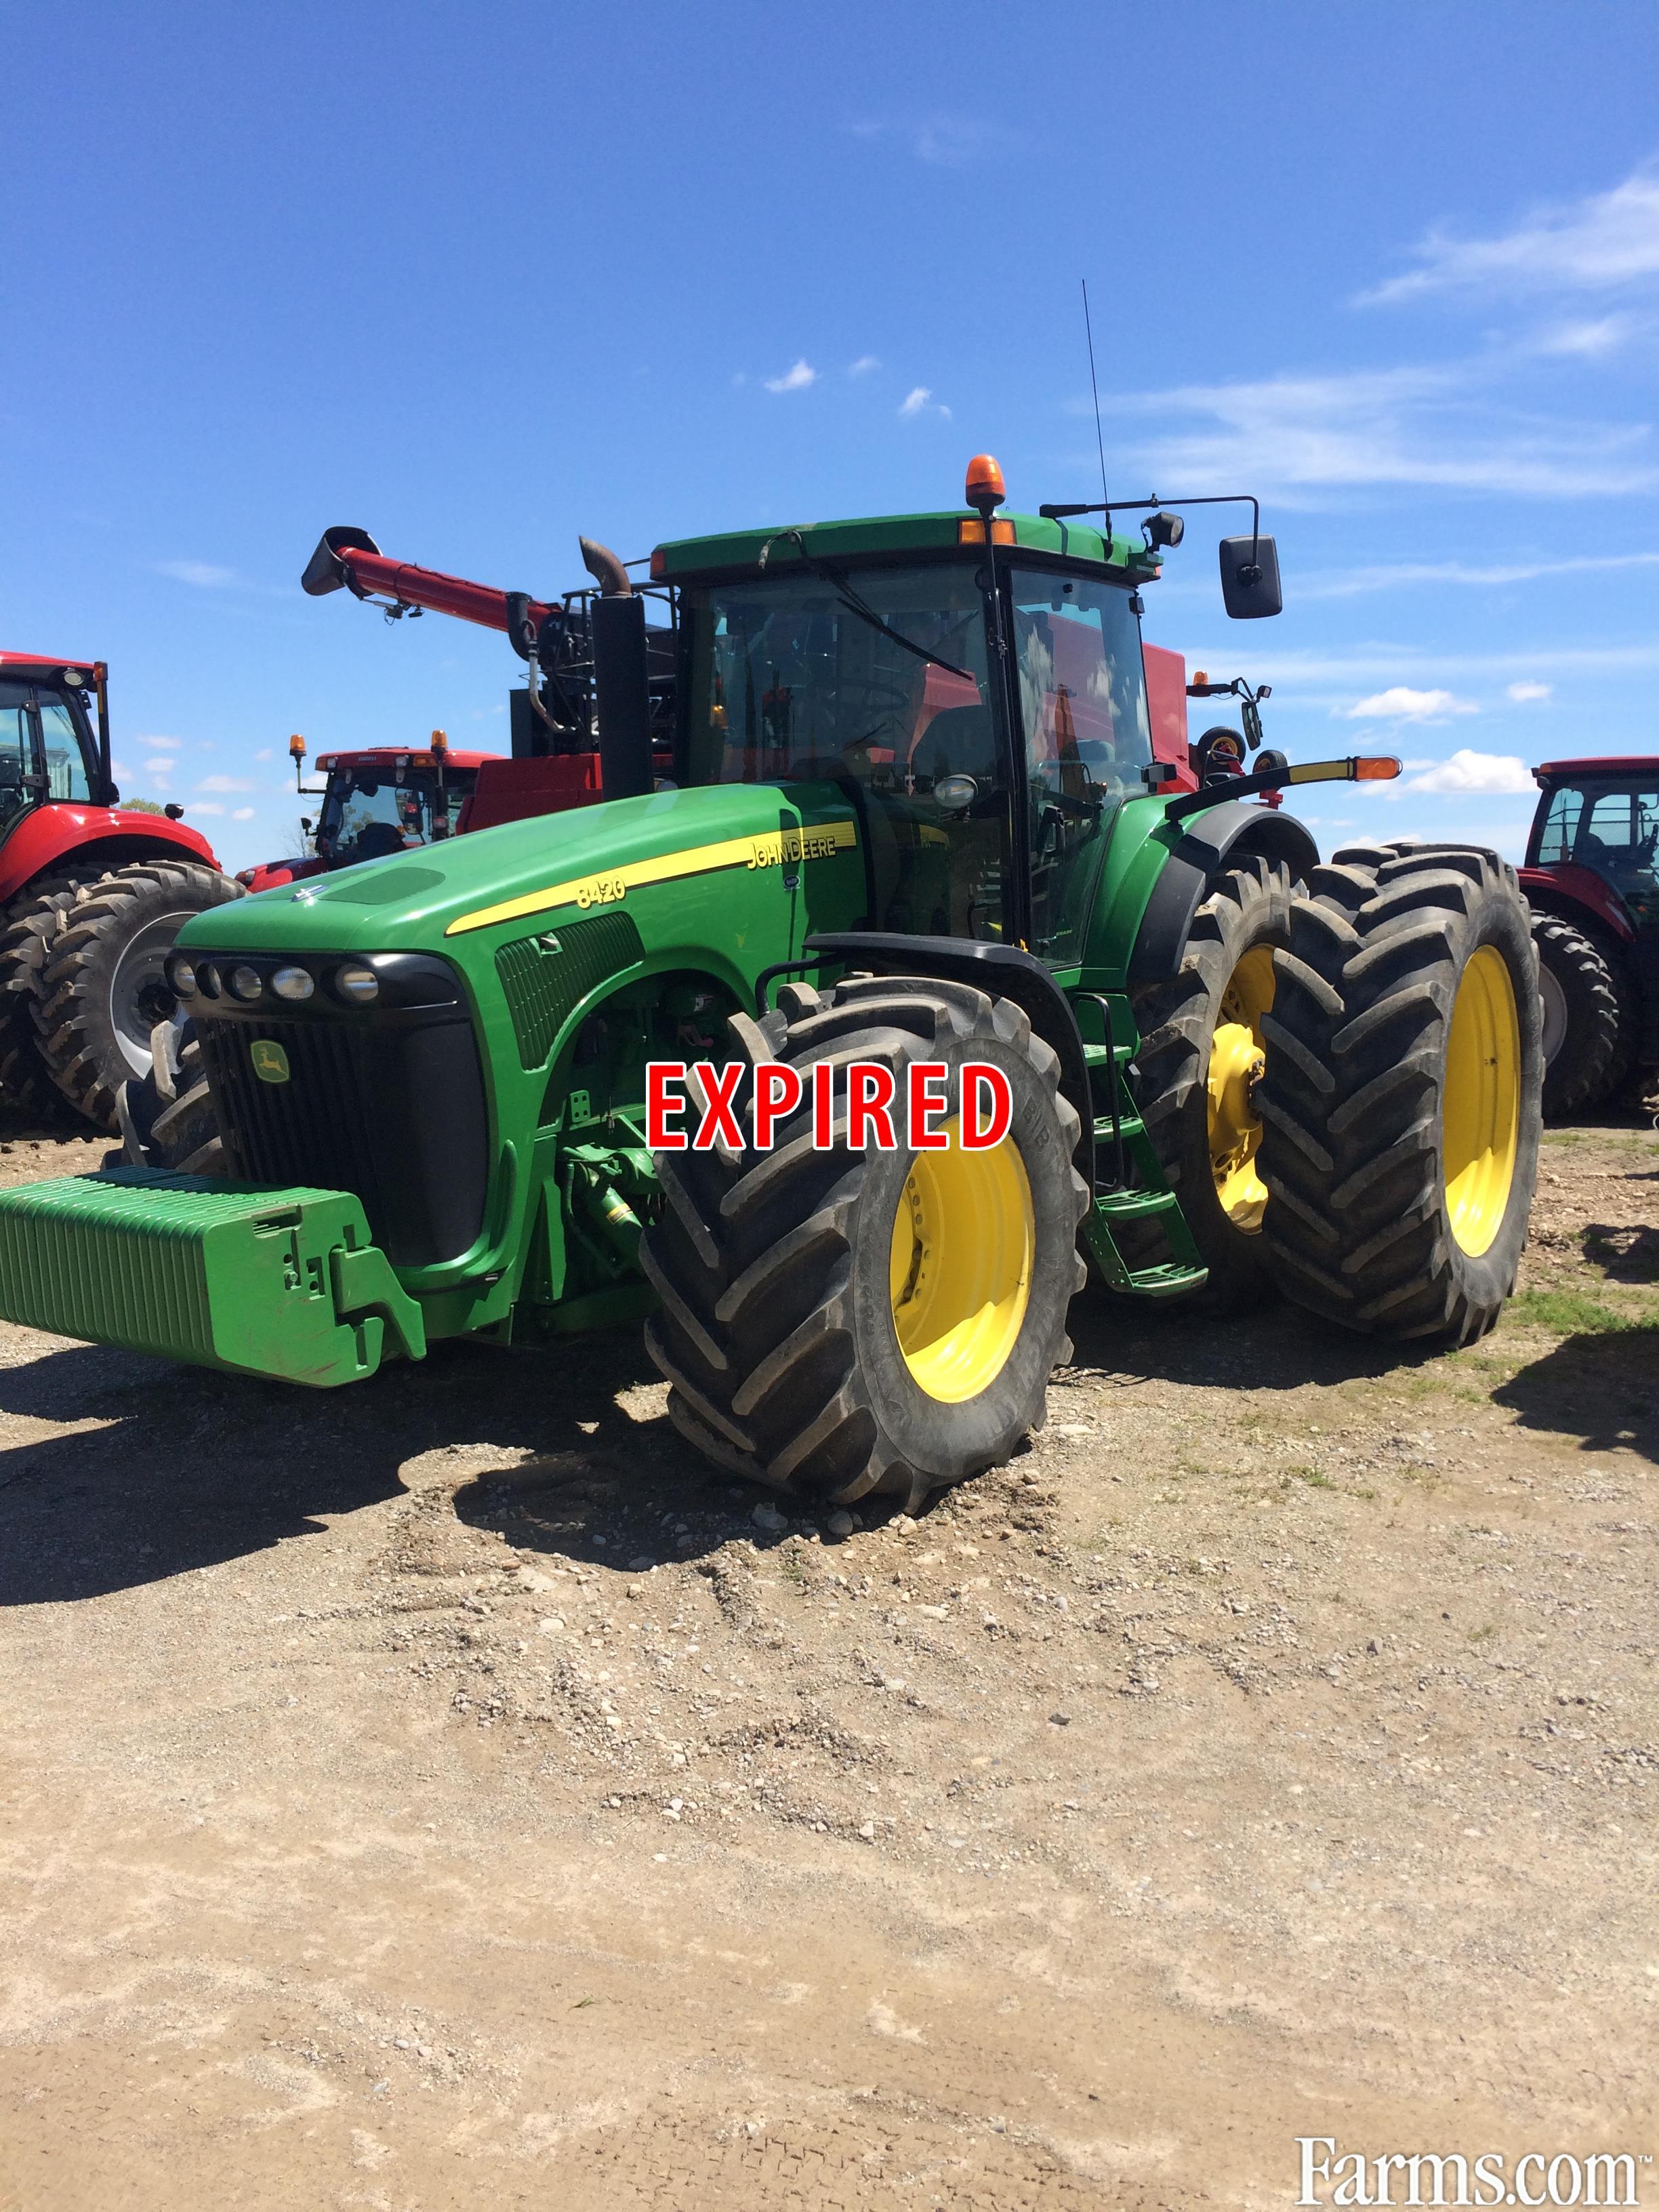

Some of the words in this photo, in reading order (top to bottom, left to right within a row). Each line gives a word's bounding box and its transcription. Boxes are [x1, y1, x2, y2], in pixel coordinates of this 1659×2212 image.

[747, 842, 788, 870] JOHN
[788, 836, 836, 862] DEERE
[577, 876, 626, 909] 8420
